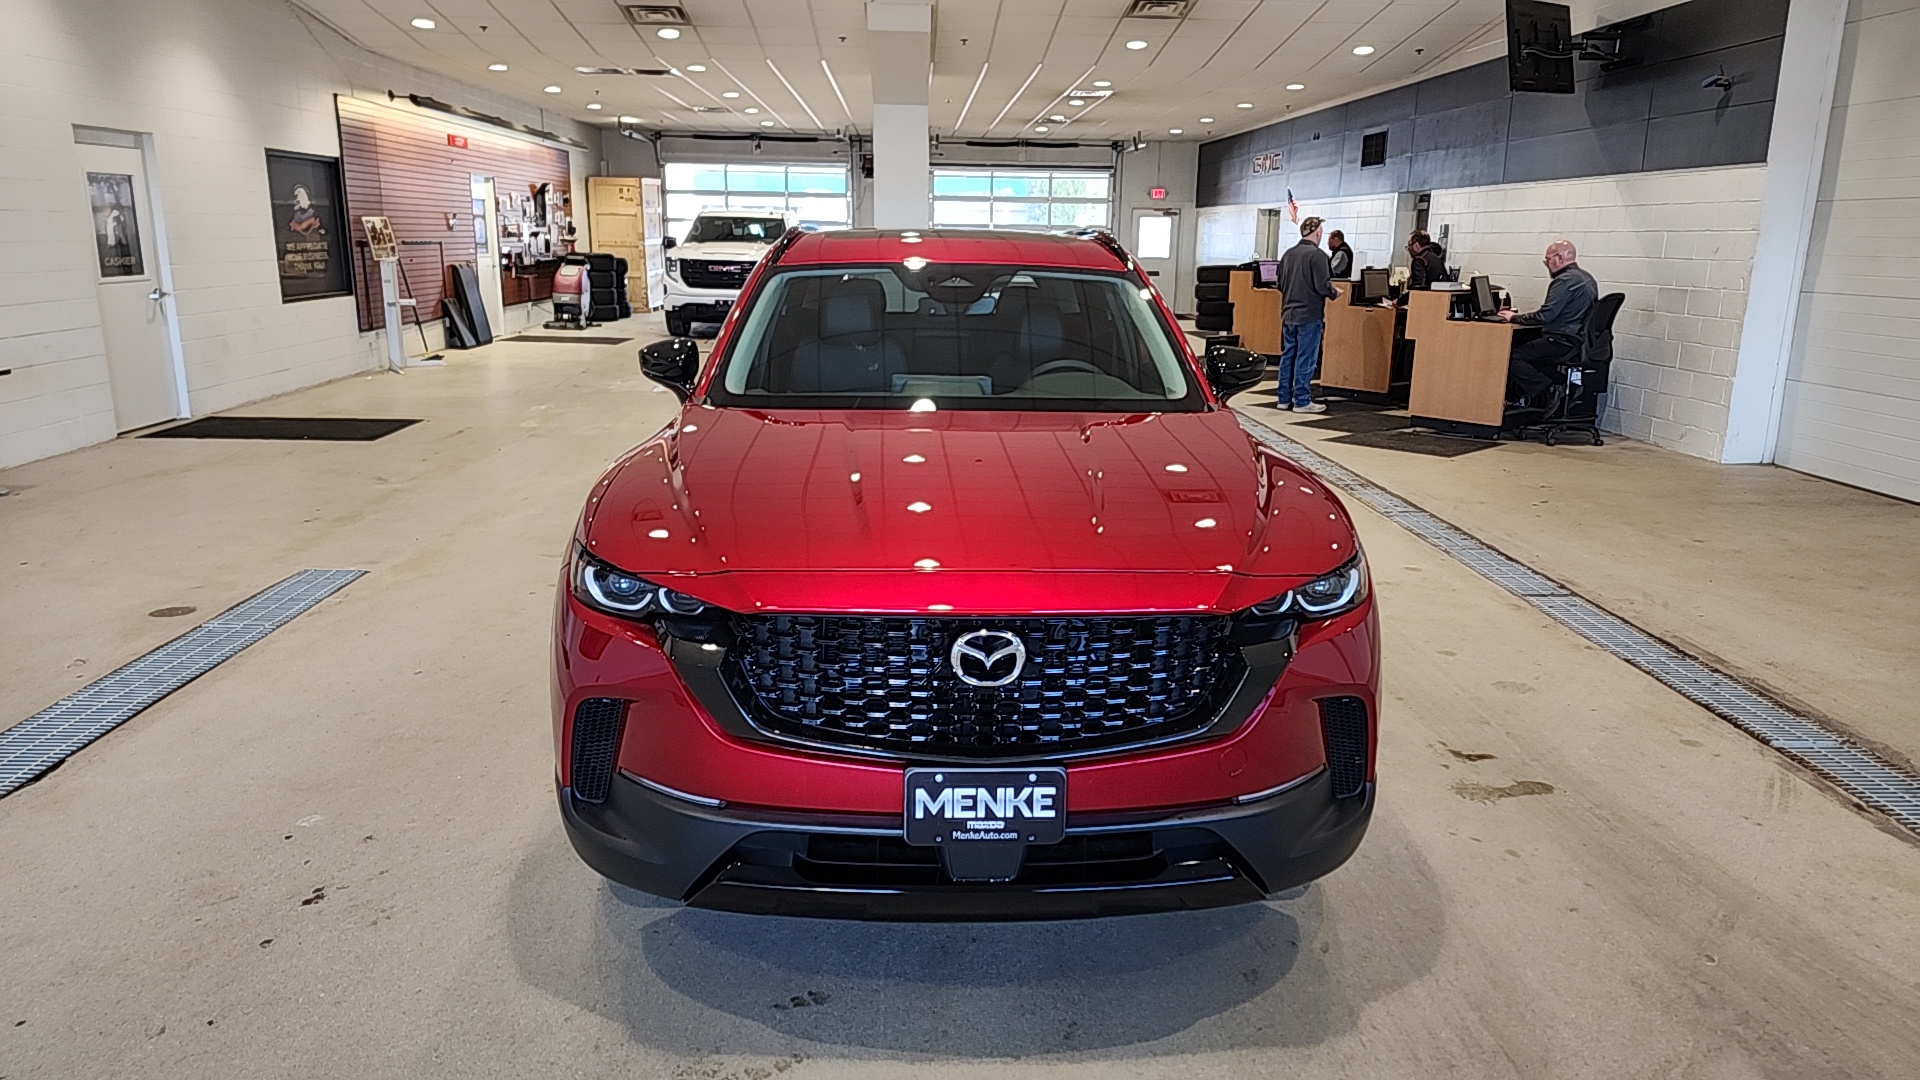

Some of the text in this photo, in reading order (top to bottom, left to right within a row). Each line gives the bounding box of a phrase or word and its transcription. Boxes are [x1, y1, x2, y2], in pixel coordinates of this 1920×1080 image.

[1252, 151, 1284, 175] GMC
[104, 256, 136, 266] CASHIER
[708, 264, 741, 272] GMC
[915, 787, 1056, 819] MENKE
[952, 831, 1018, 840] MenkeAuto.com
